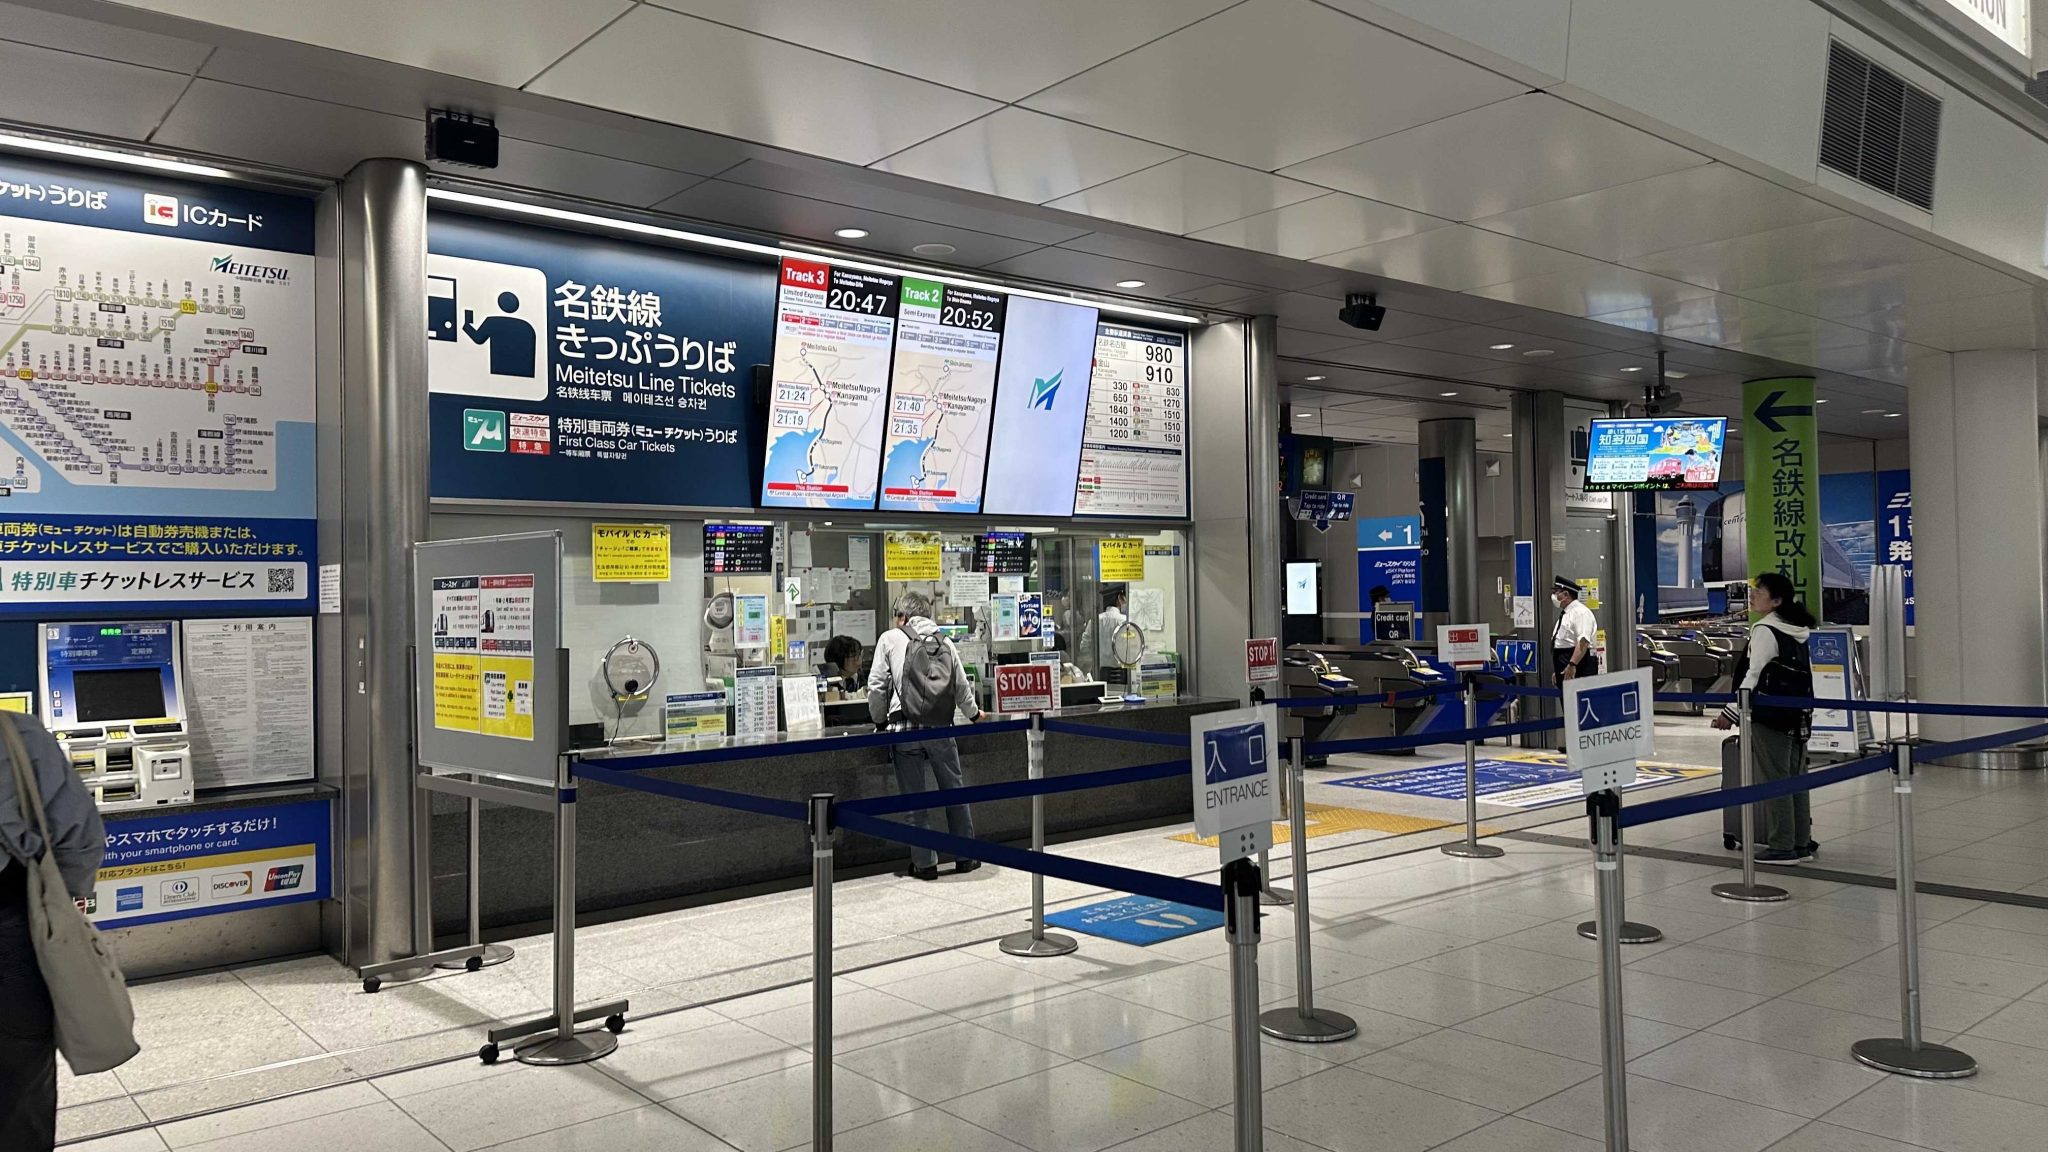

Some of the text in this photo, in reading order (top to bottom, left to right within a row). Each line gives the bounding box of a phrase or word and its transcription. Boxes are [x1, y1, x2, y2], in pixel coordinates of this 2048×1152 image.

[183, 204, 264, 232] ICカード
[25, 258, 38, 267] 1840
[786, 268, 825, 284] Track 3
[9, 294, 23, 304] 1750
[56, 288, 70, 299] 1810
[784, 289, 825, 300] Limited Express
[905, 287, 939, 303] Track 2
[182, 302, 195, 311] 1510
[554, 280, 663, 328] 名鉄線
[829, 289, 887, 315] 20:47
[904, 308, 936, 320] Semi Express
[942, 306, 994, 331] 20:52
[161, 319, 174, 328] 1510
[241, 330, 253, 339] 1840
[555, 323, 737, 374] きっぷうりば
[827, 345, 838, 353] Gifu
[1146, 345, 1173, 364] 980
[1098, 359, 1110, 368] 金山
[1146, 365, 1173, 384] 910
[556, 363, 736, 398] Meitetsu Line Tickets
[1113, 381, 1128, 391] 330
[832, 382, 881, 394] Meitetsu Nagoya
[1166, 387, 1180, 397] 830
[556, 386, 612, 402] 名铁线车票
[780, 390, 805, 401] 21:24
[837, 392, 868, 402] Kanayama
[944, 393, 987, 404] Meitetsu Nagoya
[1113, 393, 1128, 403] 650
[677, 396, 707, 410] 승차권
[897, 400, 921, 412] 21:40
[948, 402, 976, 411] Kanayama
[1164, 399, 1180, 408] 1270
[1109, 405, 1128, 415] 1840
[1164, 410, 1180, 420] 1510
[777, 414, 804, 425] 21:19
[1110, 417, 1128, 427] 1400
[894, 424, 918, 434] 21:35
[1164, 422, 1180, 431] 1510
[1110, 429, 1128, 438] 1200
[1164, 433, 1180, 443] 1510
[1599, 433, 1649, 445] 知多四国
[518, 441, 543, 450] 特急
[558, 434, 676, 453] First Class Car Tickets
[0, 522, 257, 539] 両券(ミューチケット)は自動券売機または、
[597, 529, 667, 539] モバイル IC カード
[1403, 525, 1412, 545] 1
[0, 540, 303, 556] チケットレスサービスでご購入いただけます。
[1031, 560, 1038, 578] 2
[11, 571, 255, 591] 特別車チケットレスサービス
[1376, 612, 1410, 621] Credit card
[222, 624, 276, 632] ご利用案内
[1388, 630, 1399, 639] QR
[1449, 631, 1478, 642] 出口
[1521, 642, 1531, 651] QR
[1580, 690, 1638, 725] 入口
[1578, 725, 1642, 750] ENTRANCE
[1206, 734, 1265, 776] 入口
[1206, 779, 1269, 810] ENTRANCE
[104, 837, 240, 861] ith your smartphone or card.
[268, 870, 301, 881] UnionPay
[213, 879, 248, 890] DISCOVER
